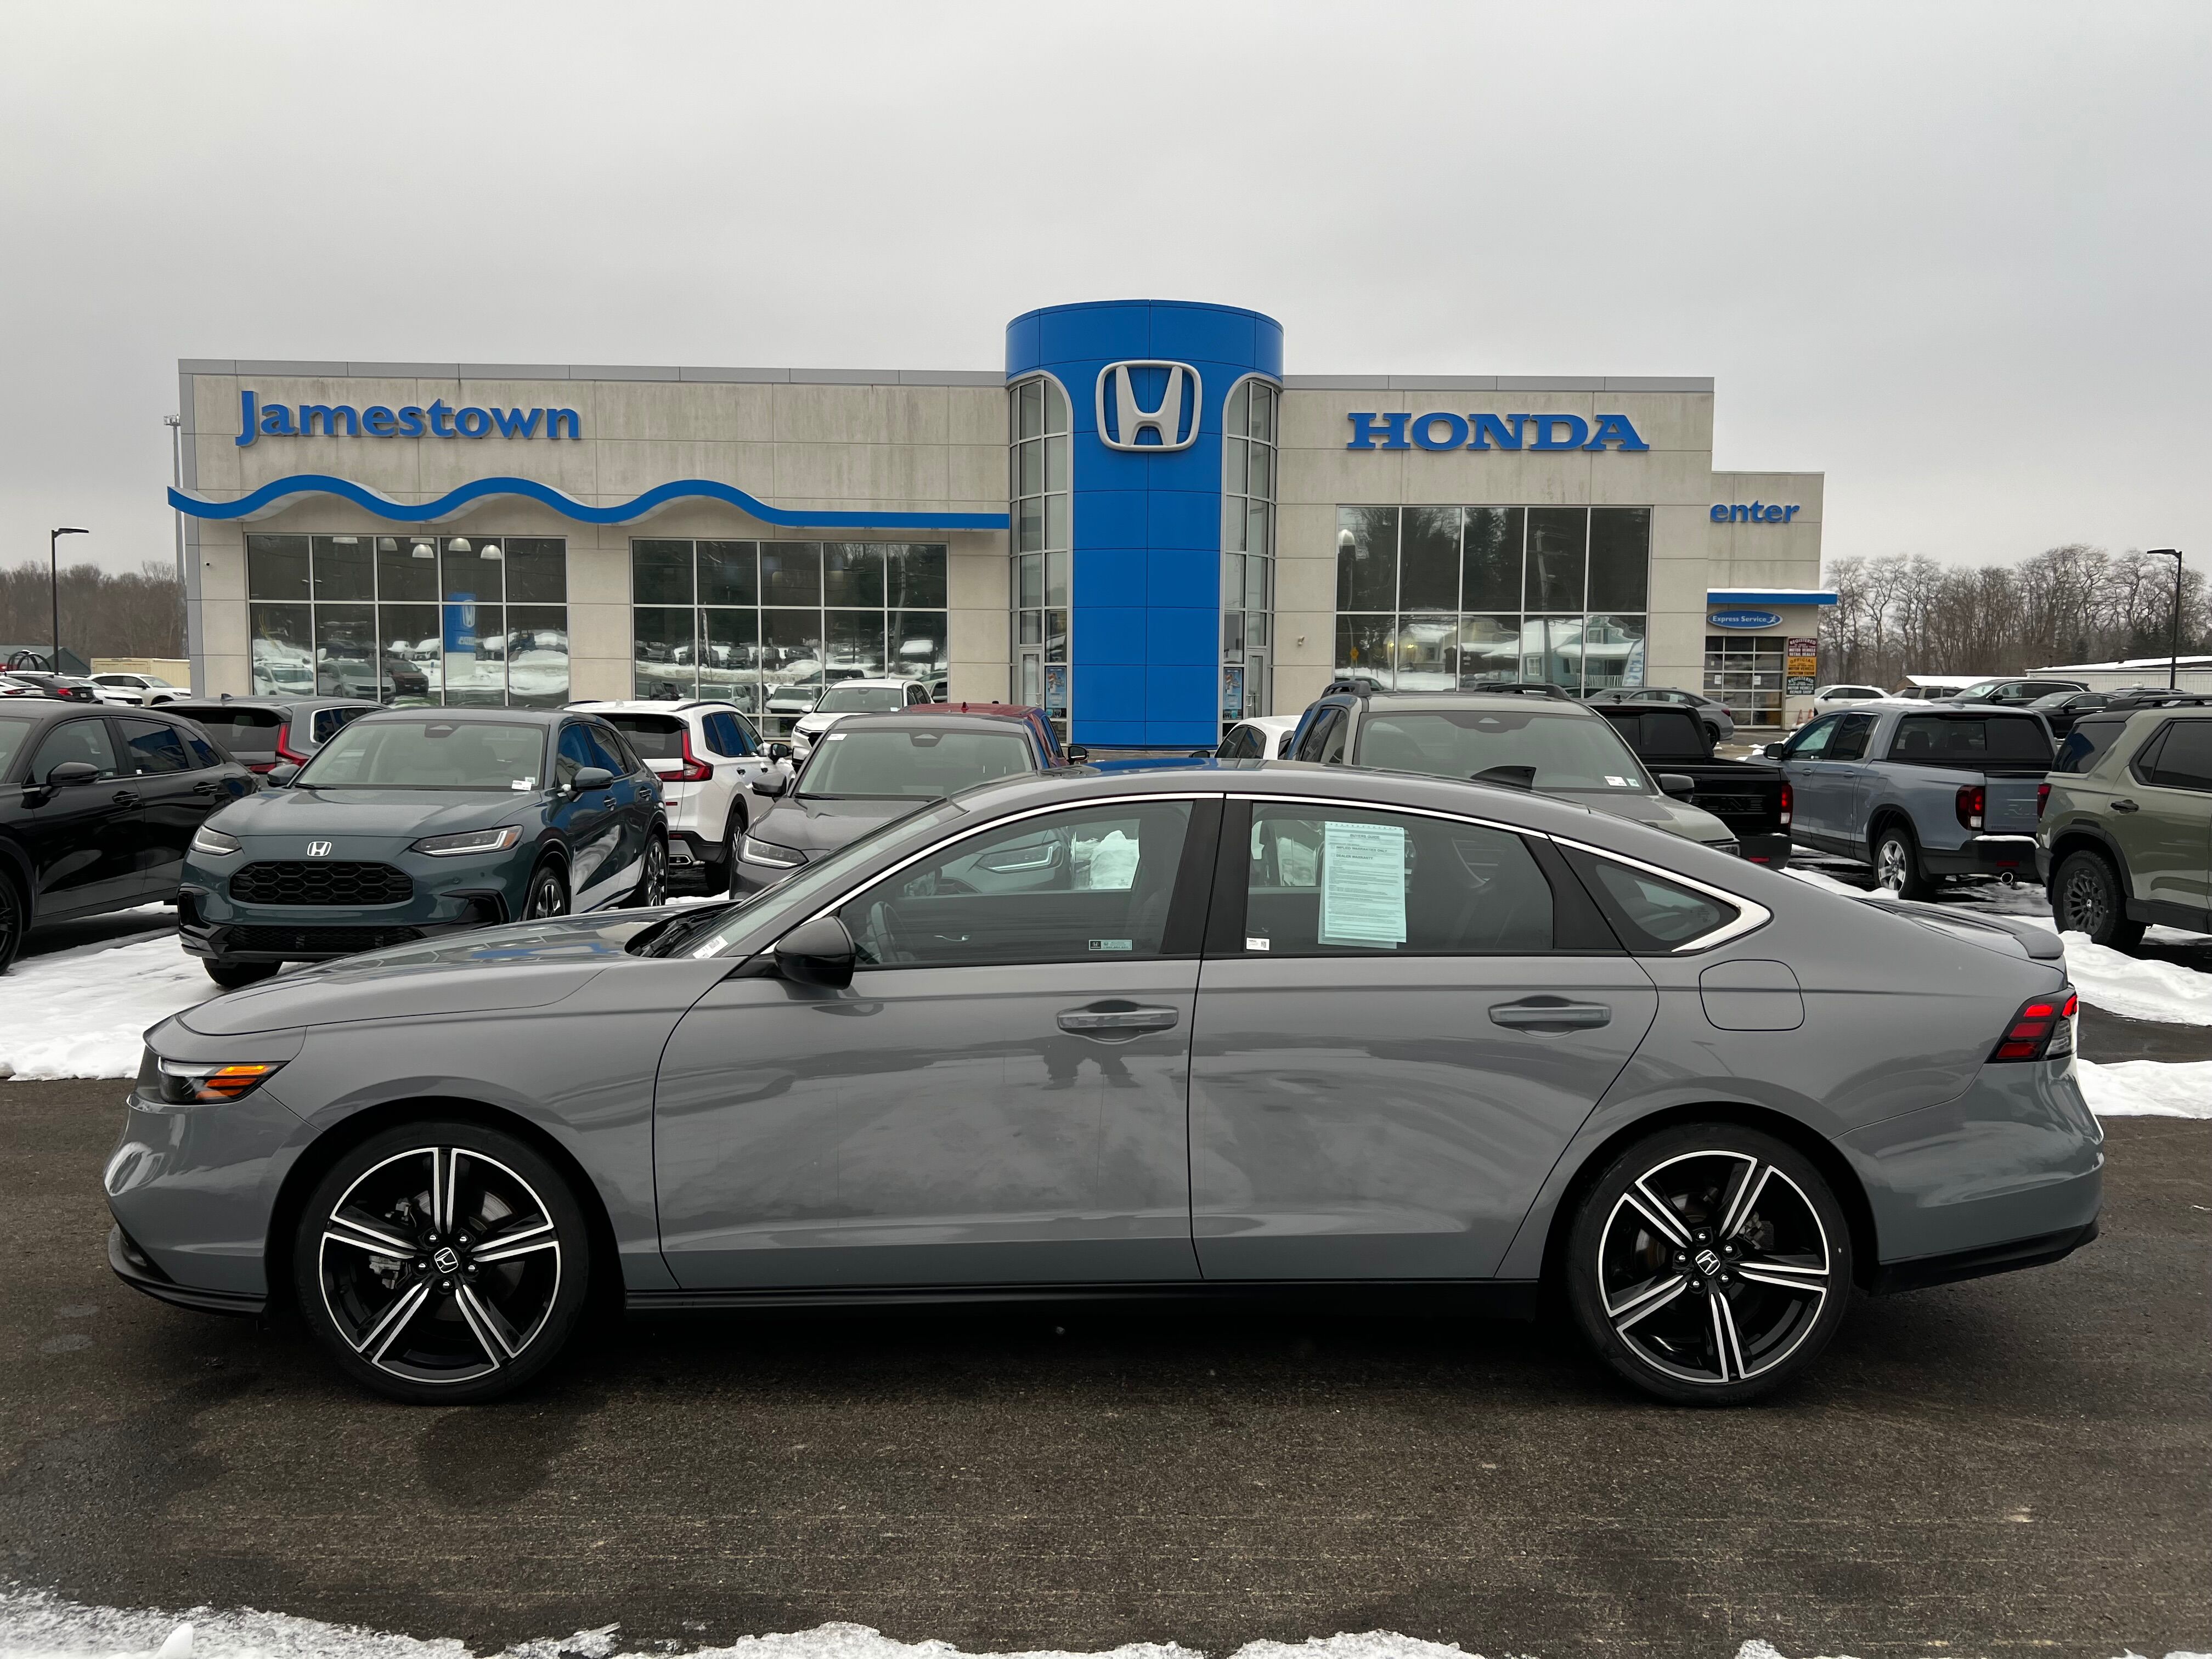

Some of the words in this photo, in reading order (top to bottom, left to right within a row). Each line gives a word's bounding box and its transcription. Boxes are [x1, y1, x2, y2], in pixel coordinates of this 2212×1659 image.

[235, 390, 582, 448] Jamestown
[1346, 411, 1651, 452] HONDA
[1709, 500, 1801, 523] enter
[1712, 615, 1739, 623] Express
